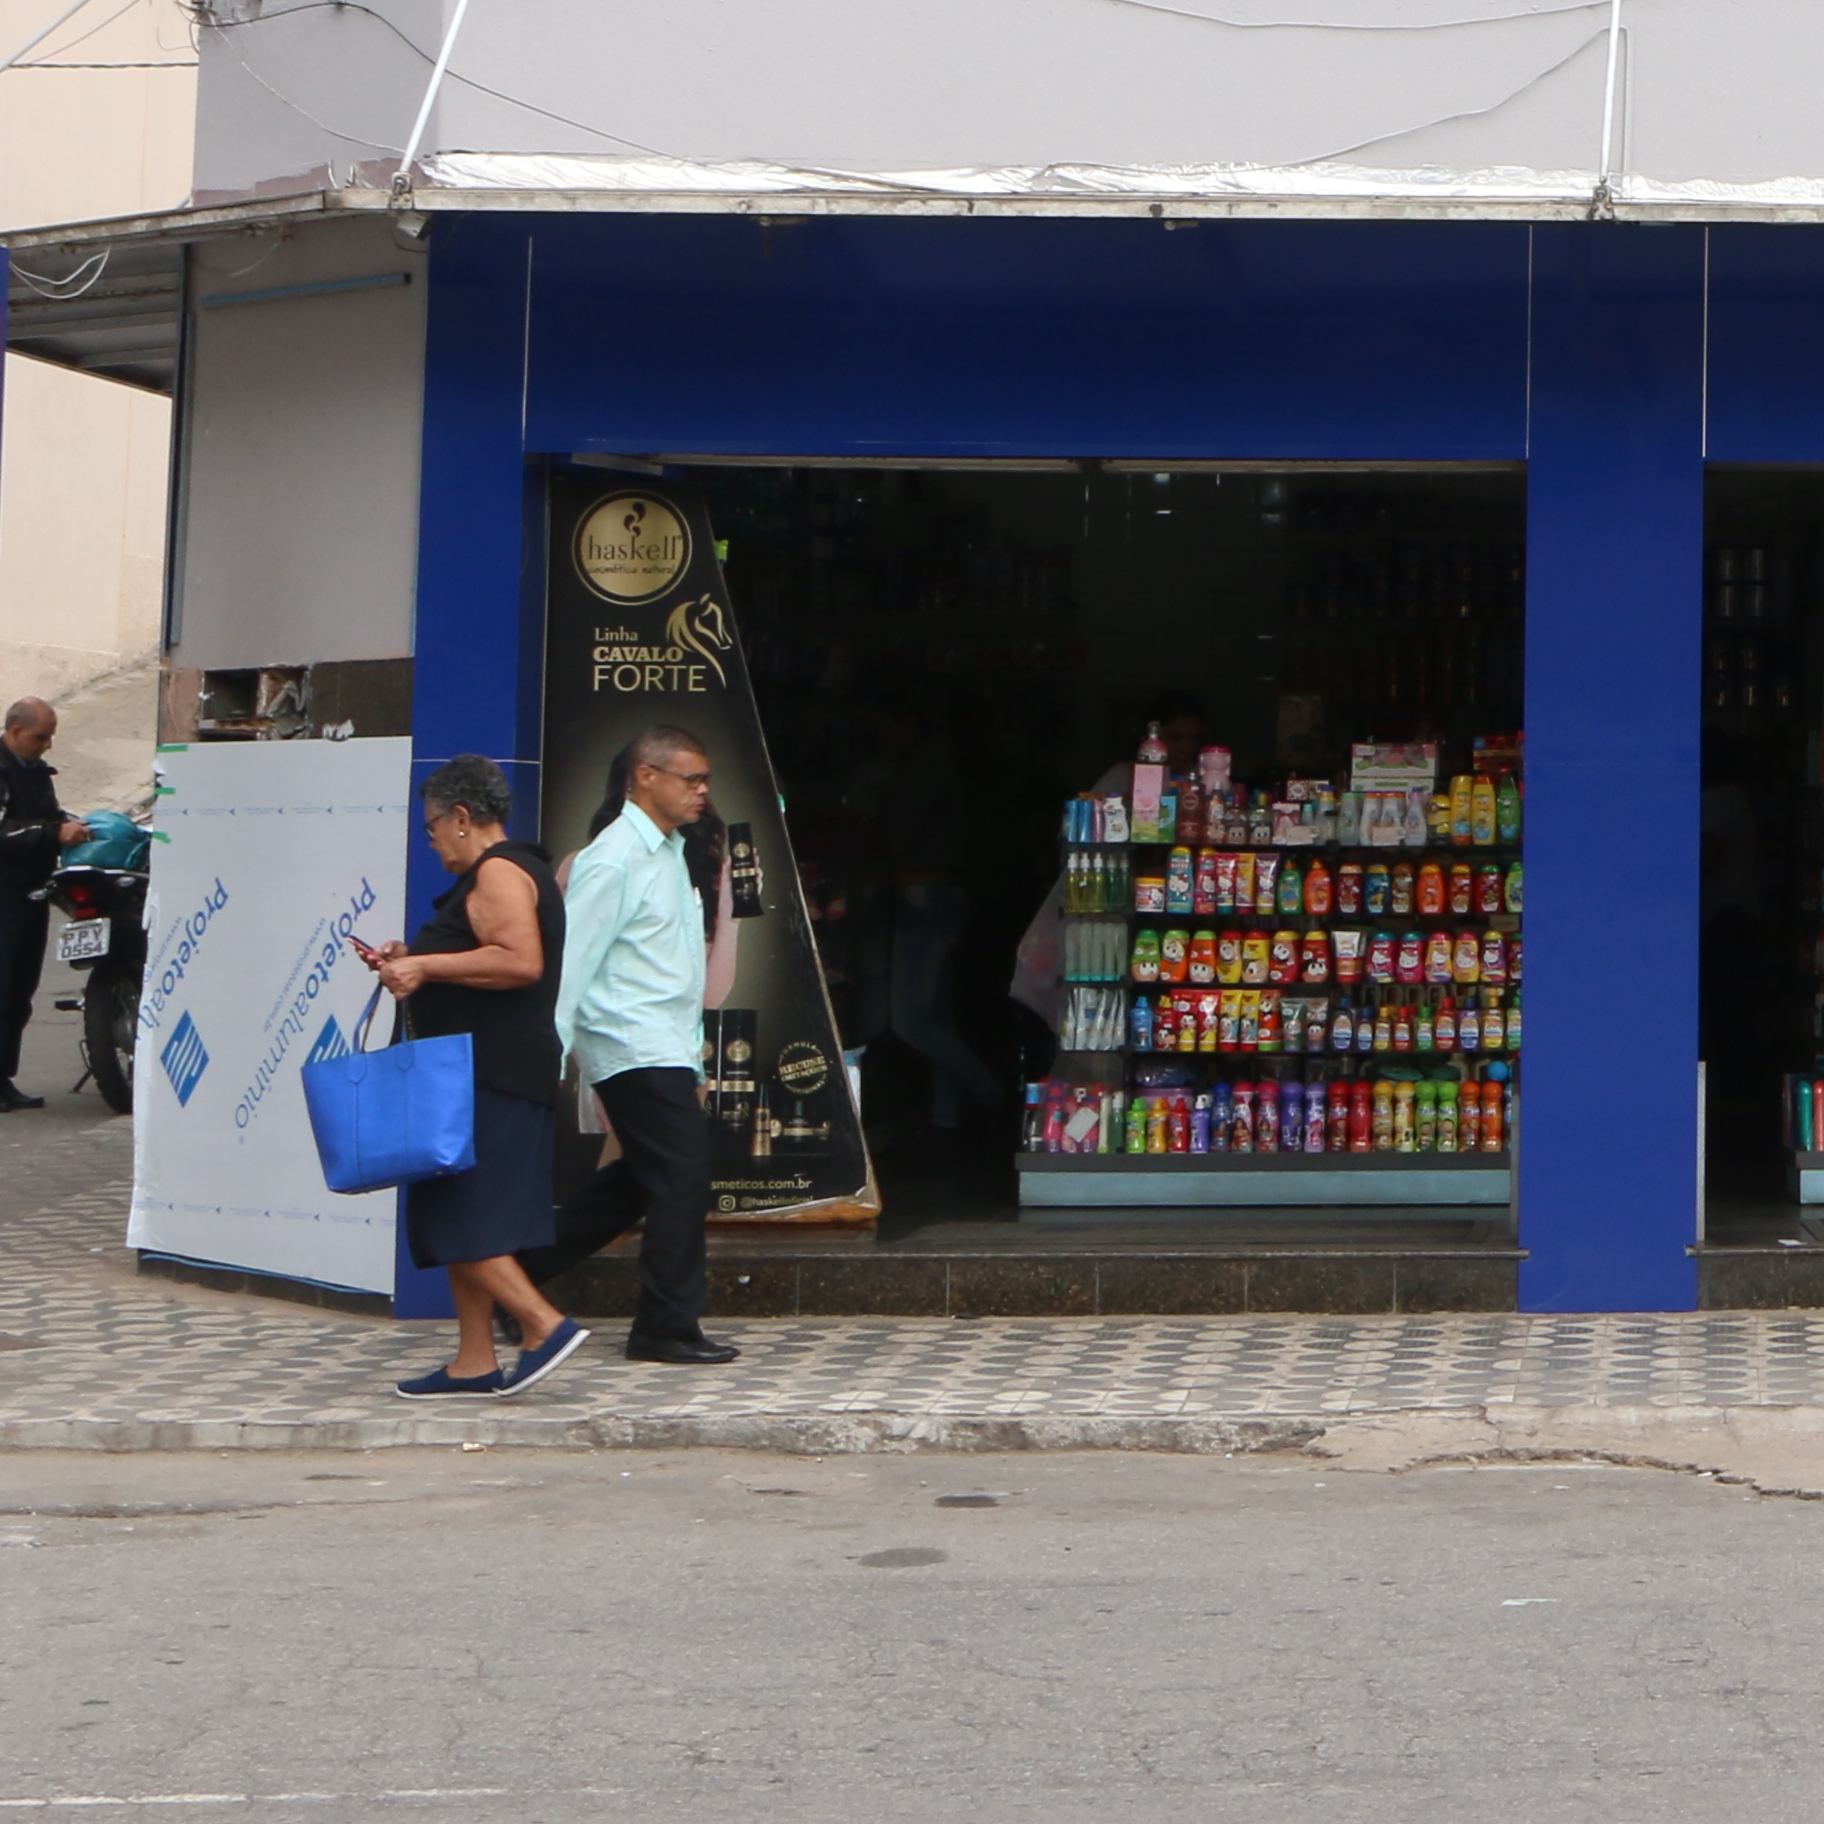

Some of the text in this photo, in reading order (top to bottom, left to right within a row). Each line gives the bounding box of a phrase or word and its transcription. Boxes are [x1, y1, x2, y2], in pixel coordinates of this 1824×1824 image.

[588, 535, 676, 560] haskell
[594, 626, 639, 642] Linha
[592, 646, 684, 662] CAVALO
[593, 664, 707, 692] FORTE
[61, 941, 102, 958] 0554
[235, 876, 377, 1130] Projetoalumínio
[779, 1055, 826, 1074] RECUSE
[710, 1178, 813, 1190] smeticos.com.br
